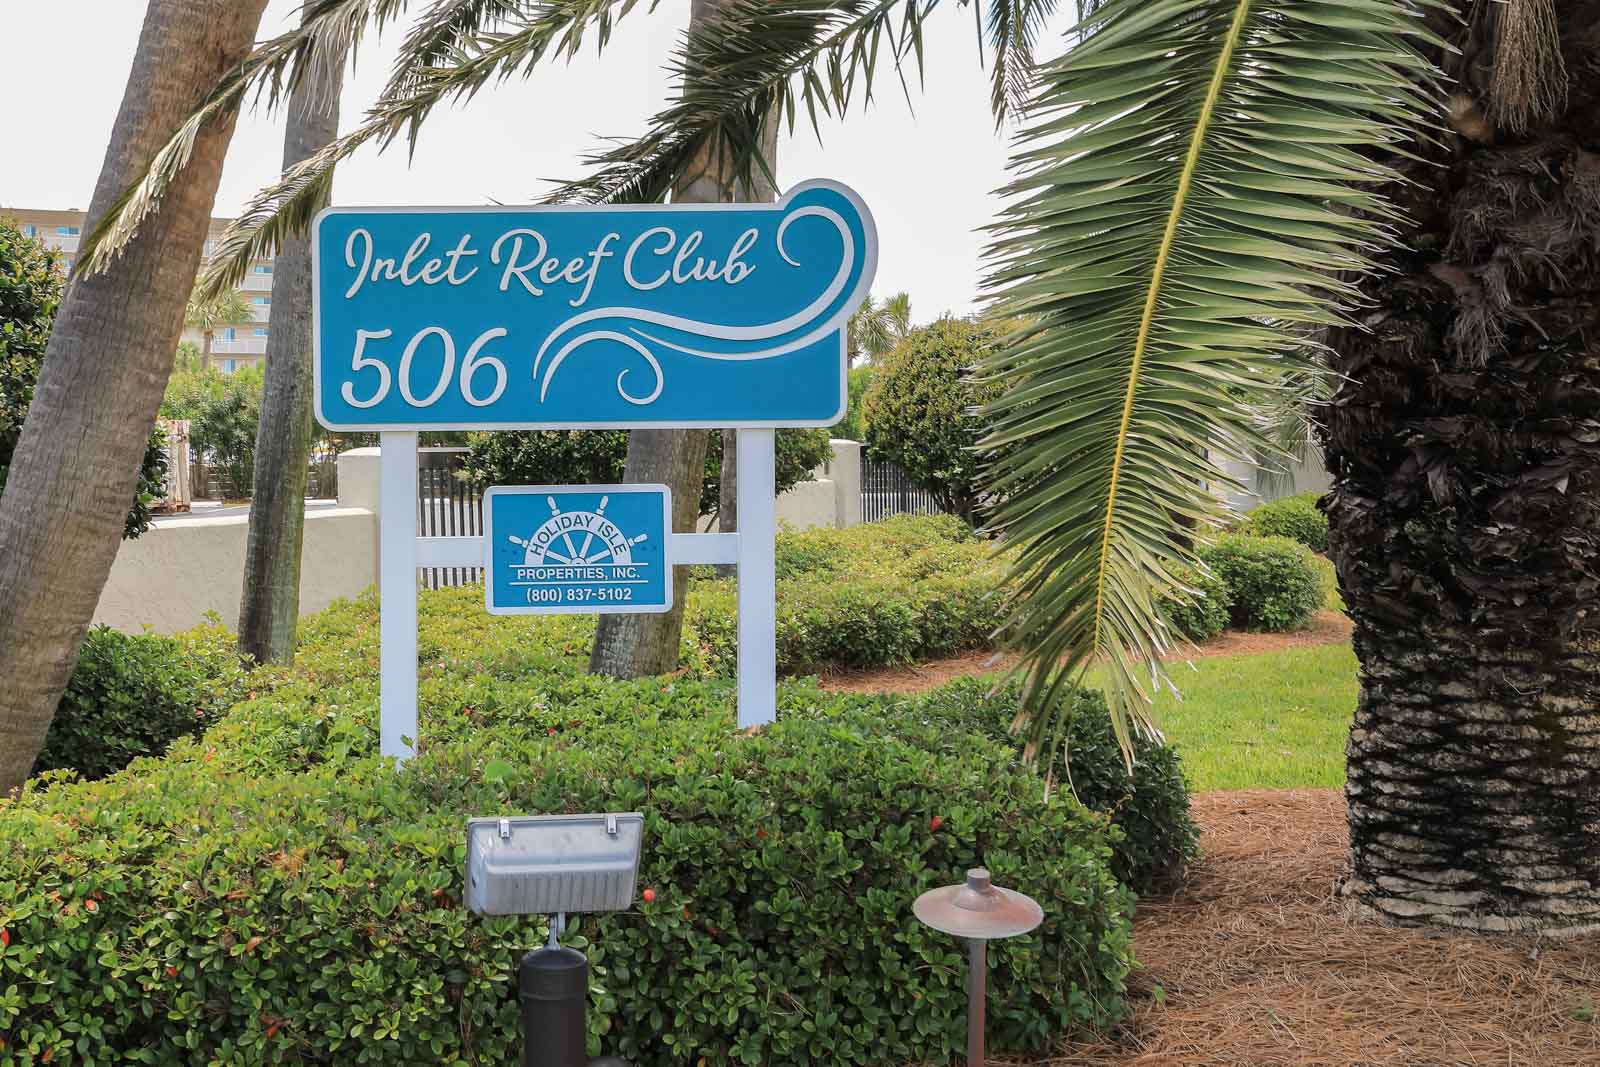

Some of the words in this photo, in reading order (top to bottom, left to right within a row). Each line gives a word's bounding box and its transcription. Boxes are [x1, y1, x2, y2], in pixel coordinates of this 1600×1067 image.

[345, 227, 478, 299] Inlet
[490, 227, 620, 308] Reef
[623, 226, 759, 291] Club
[341, 326, 508, 408] 506
[530, 515, 594, 556] HOLIDAY
[597, 521, 627, 556] ISLE
[517, 567, 608, 581] PROPERTIES,
[612, 567, 640, 579] INC.
[526, 588, 562, 602] (800)
[567, 588, 632, 601] 837-5102
